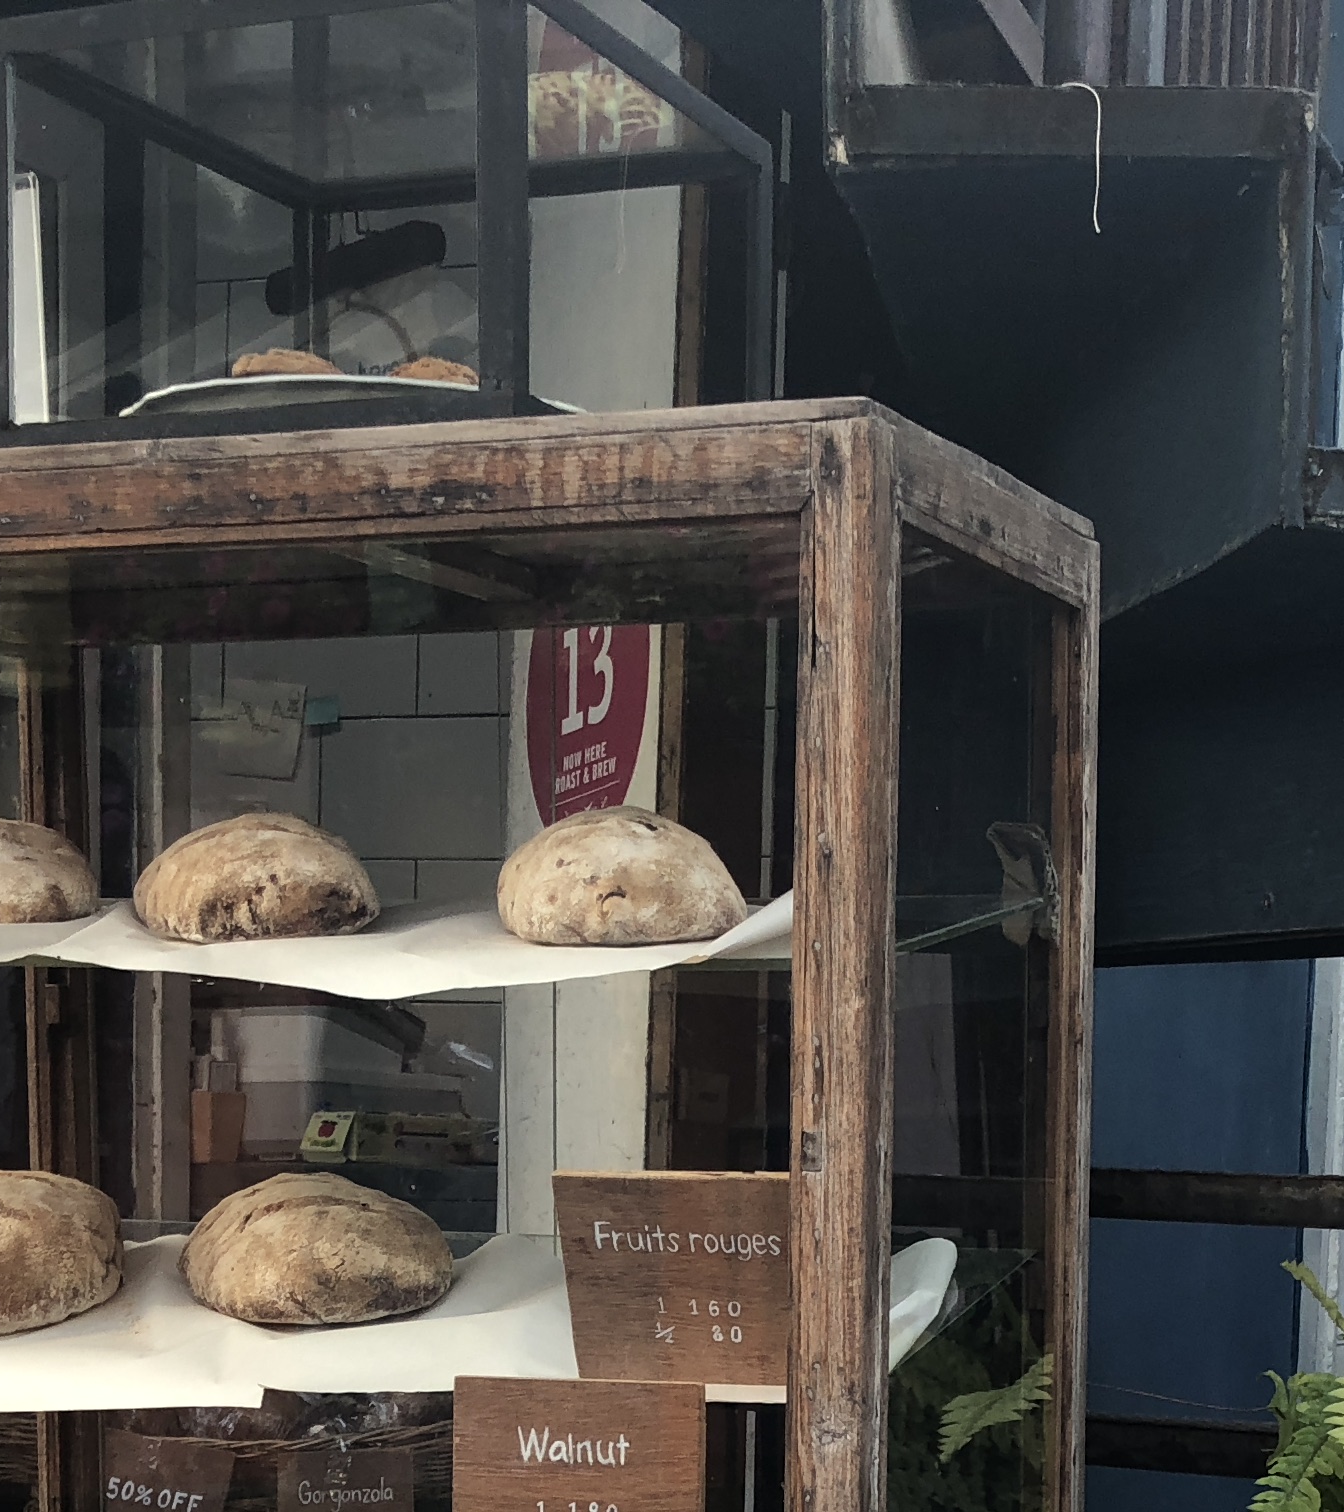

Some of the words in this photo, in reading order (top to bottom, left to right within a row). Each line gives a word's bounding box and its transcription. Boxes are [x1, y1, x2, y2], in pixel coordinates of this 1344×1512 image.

[561, 626, 614, 736] 13
[563, 750, 582, 772] NOW
[584, 741, 607, 764] HERE
[554, 769, 581, 794] ROAST
[583, 766, 590, 784] &
[592, 757, 616, 780] BREW
[593, 1221, 680, 1252] Fruits
[688, 1232, 782, 1262] rouges
[657, 1296, 668, 1314] 1
[688, 1298, 741, 1317] 160
[711, 1324, 742, 1343] 80
[517, 1425, 630, 1468] Walnut
[106, 1476, 152, 1507] 50%
[297, 1477, 394, 1512] Gorgonzola
